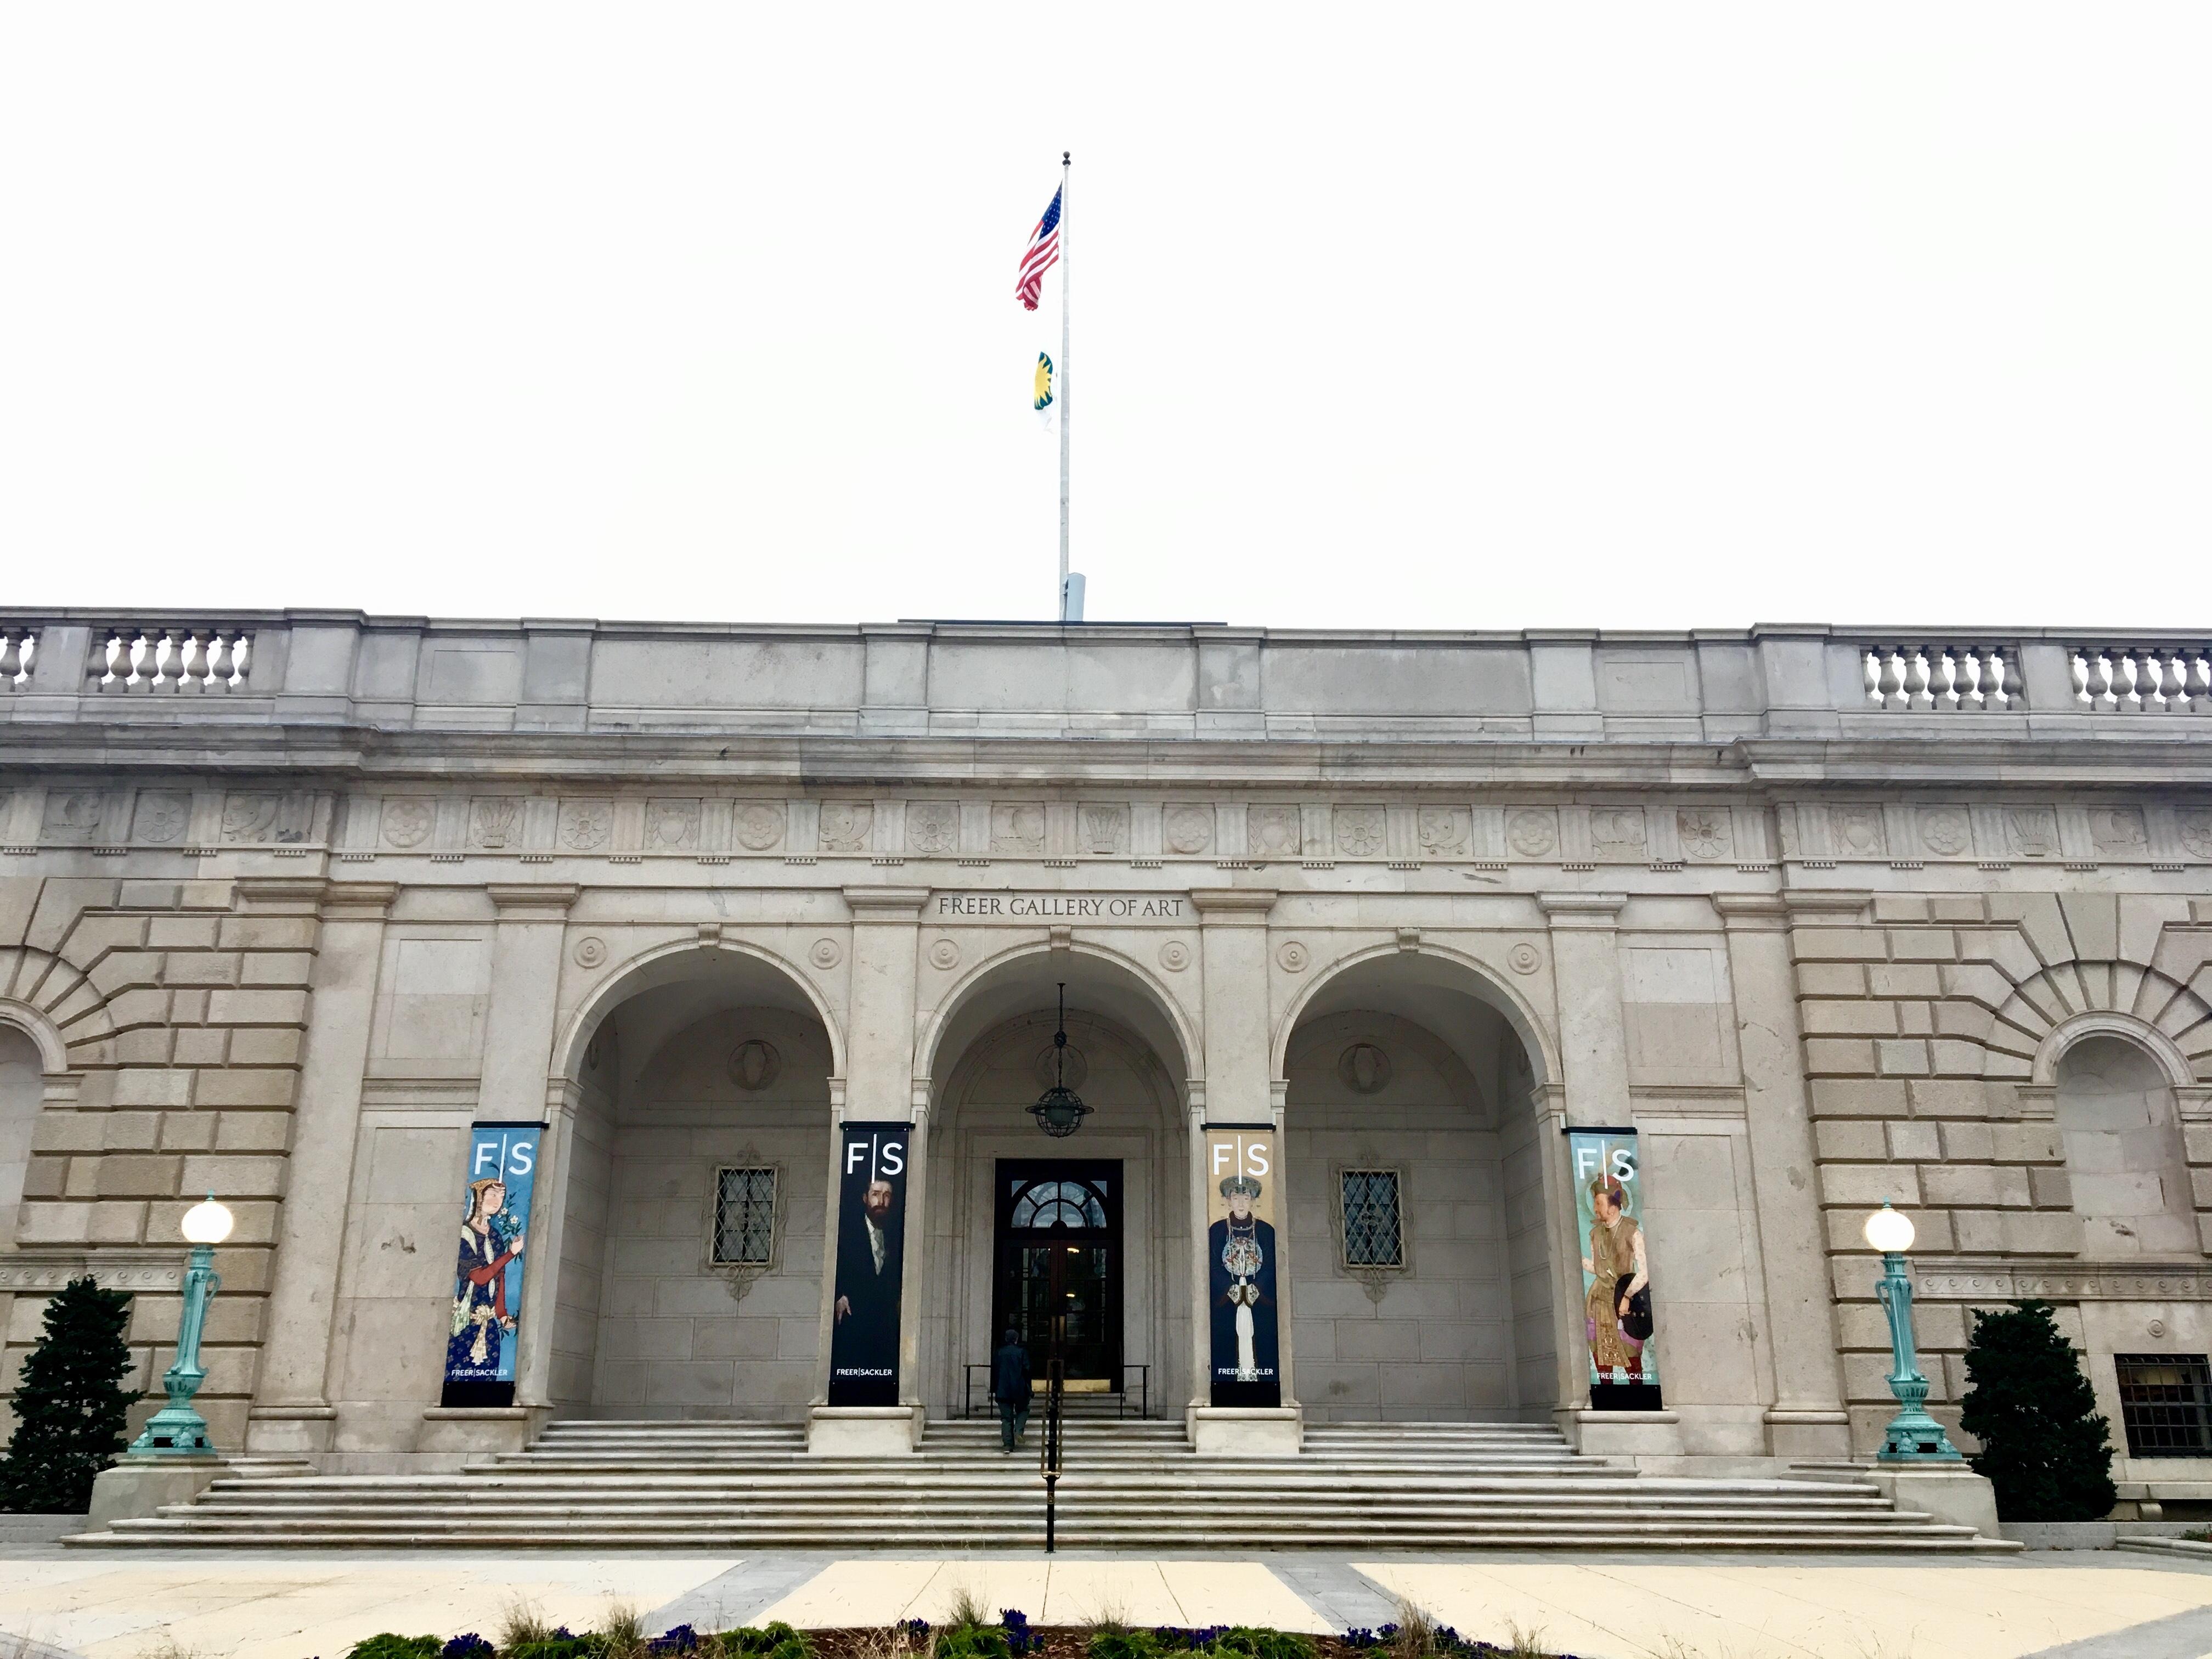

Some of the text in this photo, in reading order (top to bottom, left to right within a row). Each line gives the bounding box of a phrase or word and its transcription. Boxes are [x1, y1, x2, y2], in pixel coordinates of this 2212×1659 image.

[938, 898, 1183, 917] FREER GALLERY OF ART
